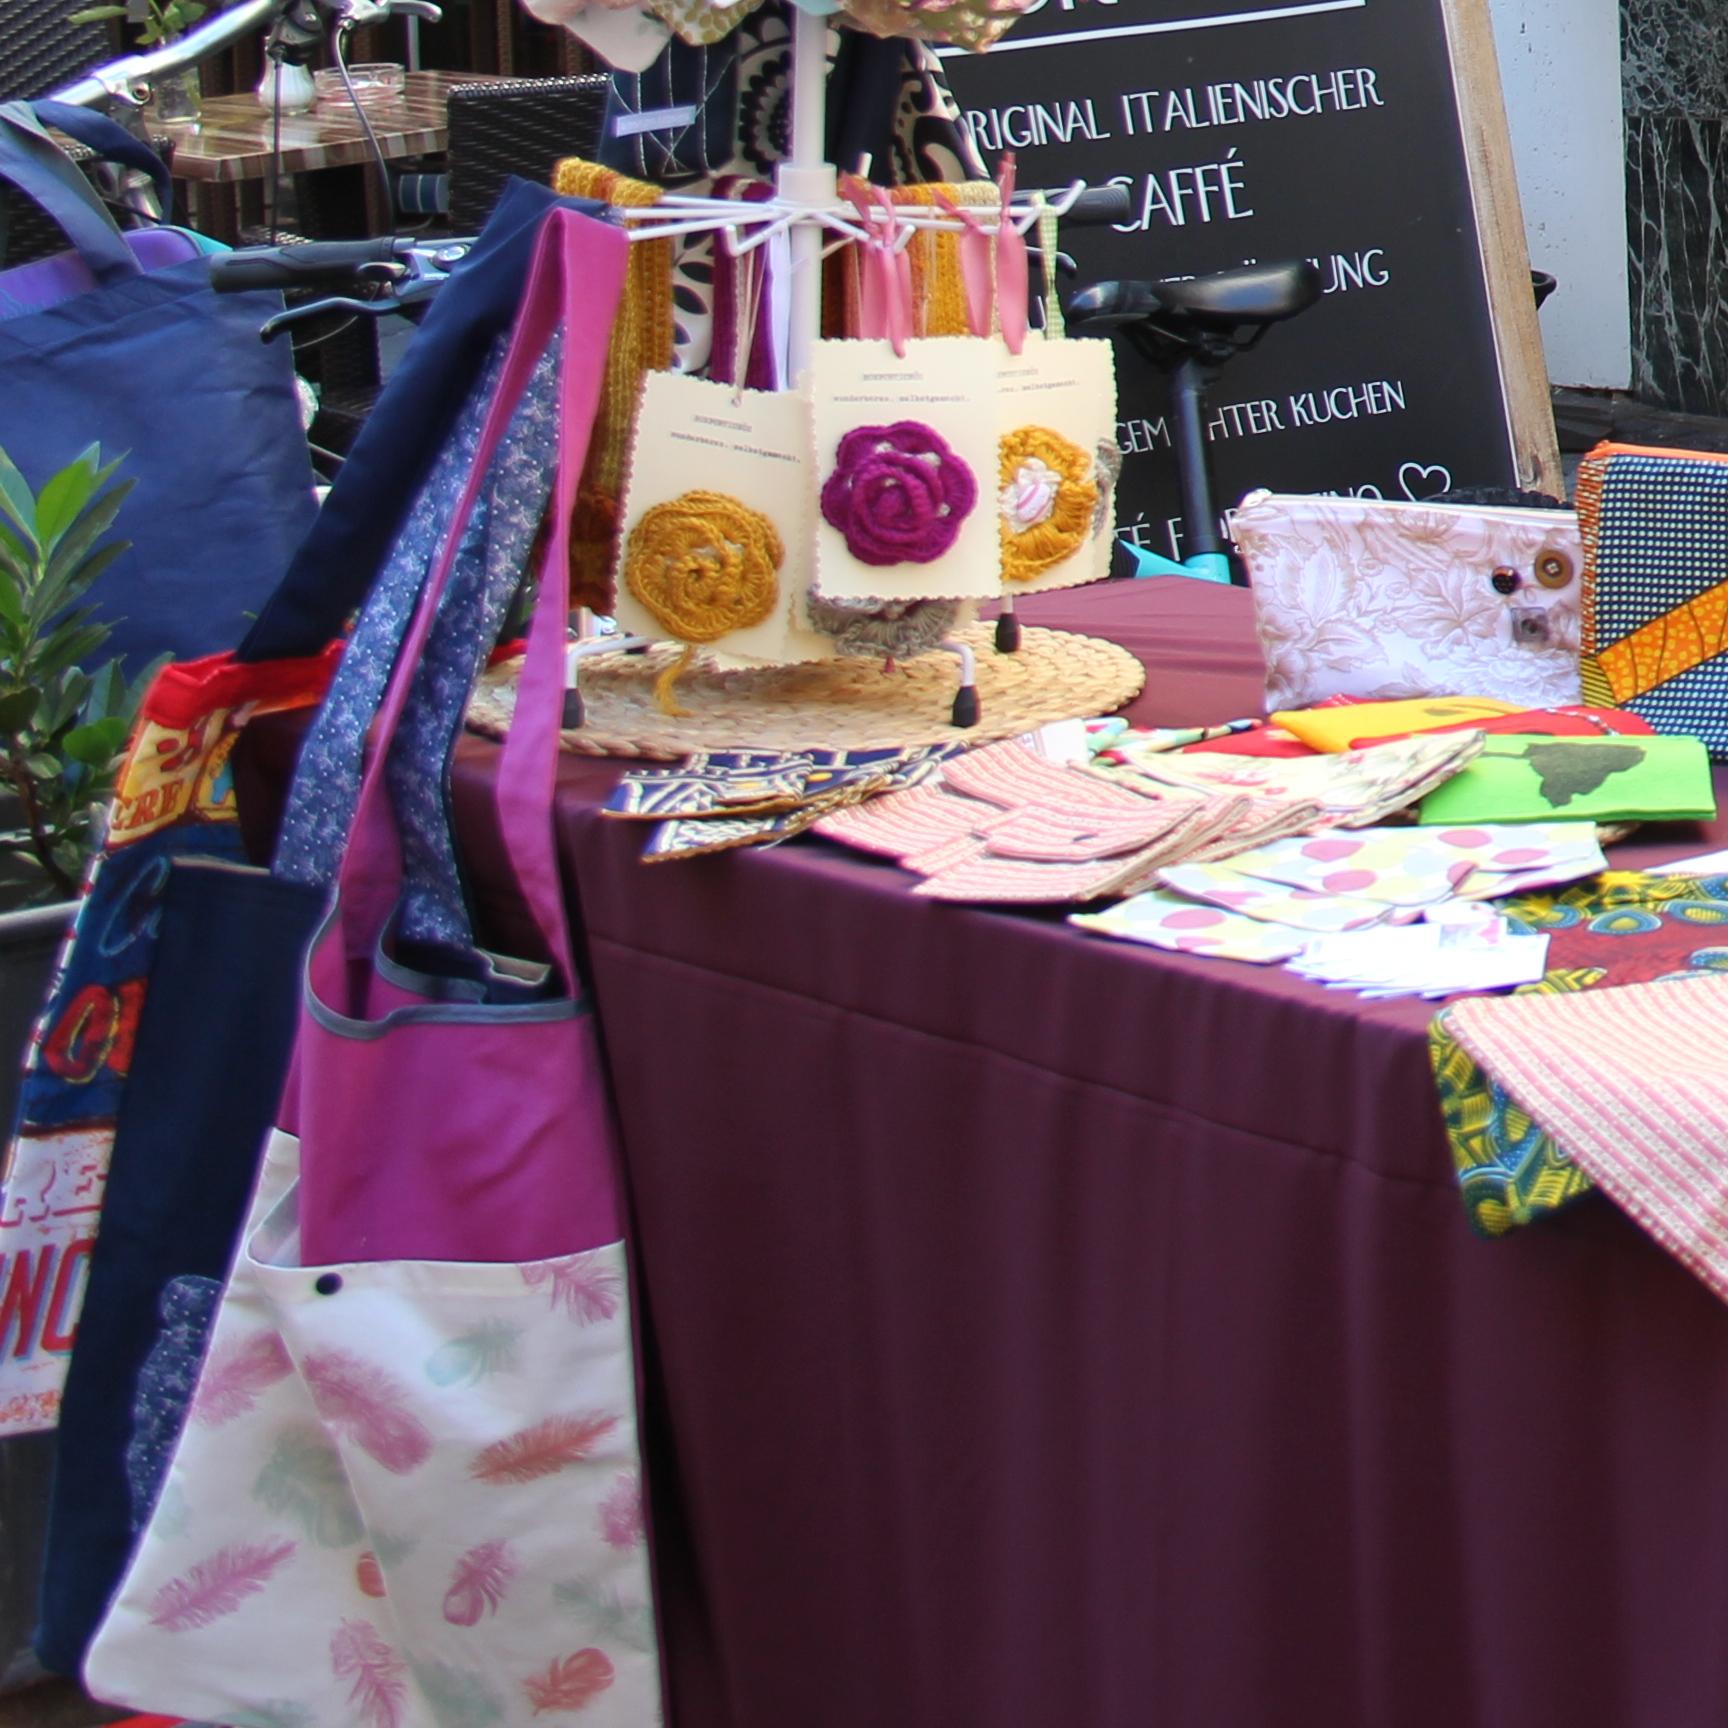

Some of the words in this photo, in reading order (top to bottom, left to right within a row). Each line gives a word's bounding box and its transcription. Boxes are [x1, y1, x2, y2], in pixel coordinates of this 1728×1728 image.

[964, 98, 1111, 151] RIGINAL
[1120, 67, 1384, 136] ITALIENISCHER
[1289, 379, 1407, 428] KUCHEN
